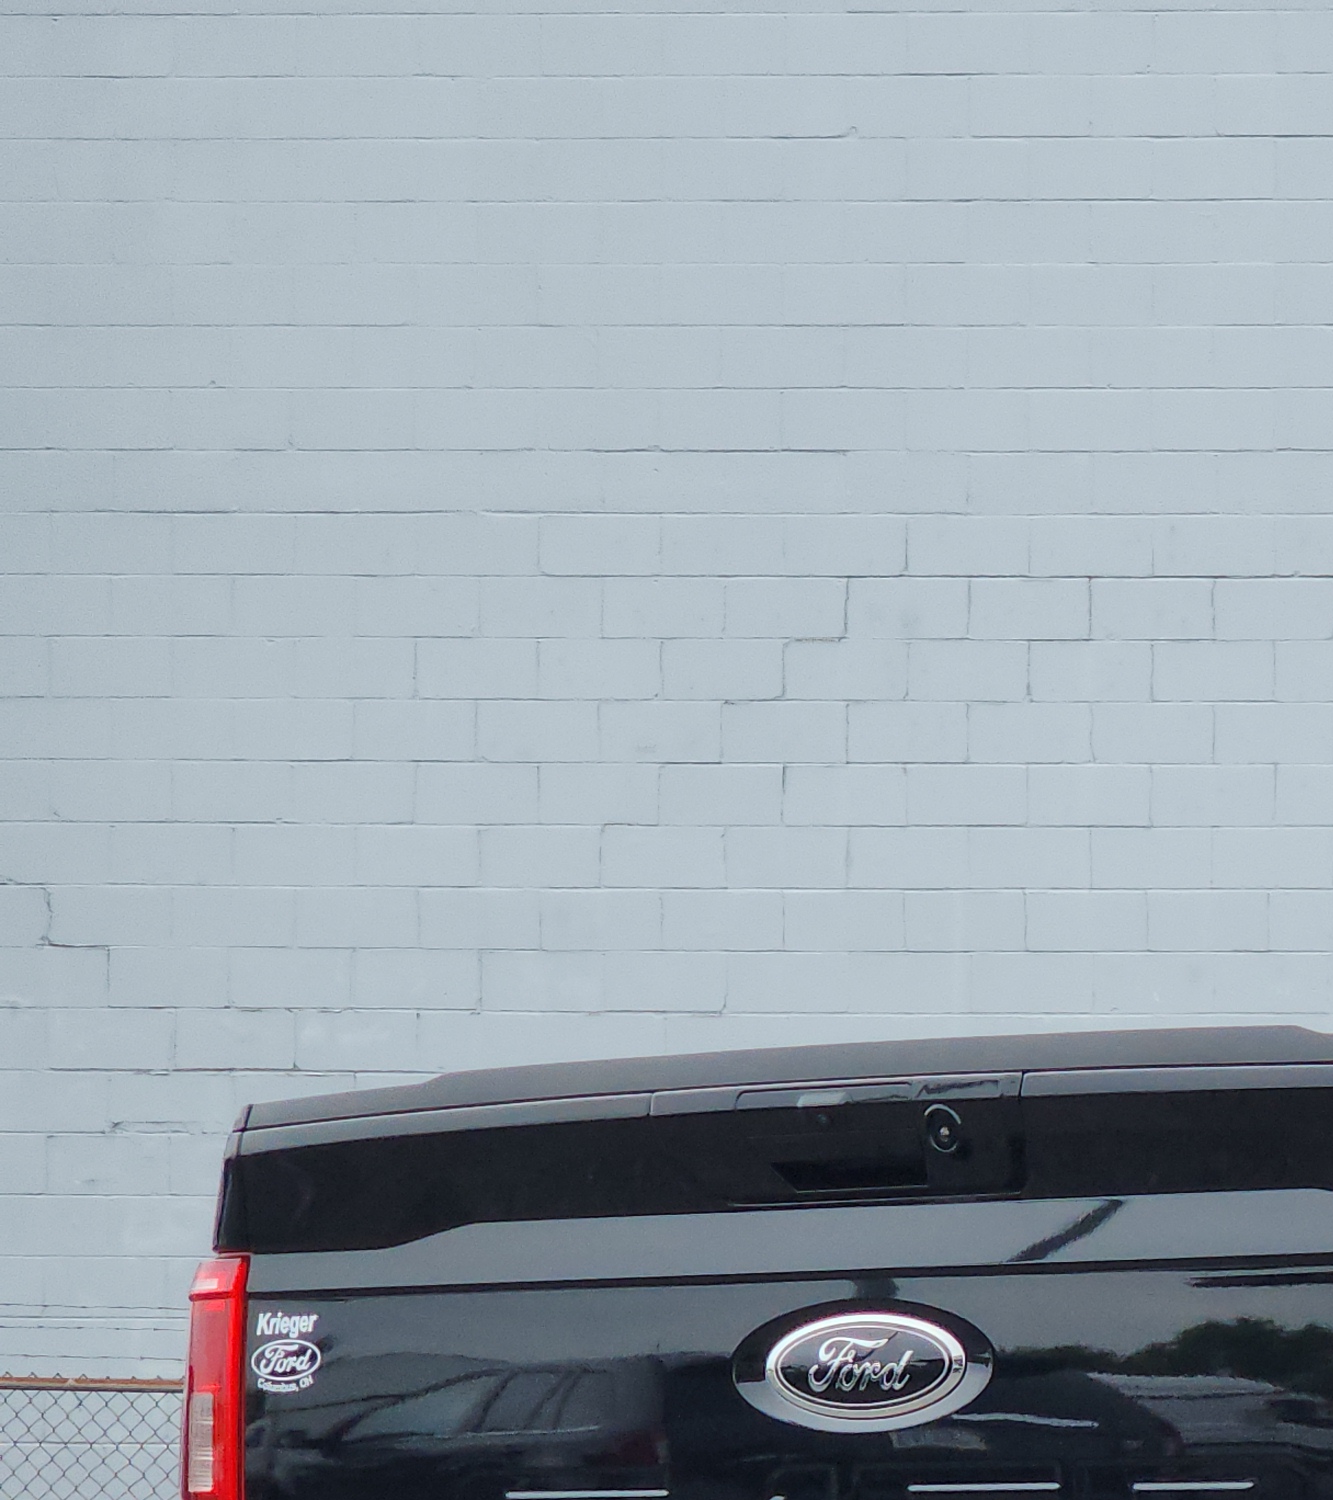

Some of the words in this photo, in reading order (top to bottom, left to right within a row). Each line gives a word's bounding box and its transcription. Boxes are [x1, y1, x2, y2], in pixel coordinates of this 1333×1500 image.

[256, 1311, 319, 1338] Krieger
[259, 1344, 312, 1375] Ford
[808, 1336, 914, 1393] Ford
